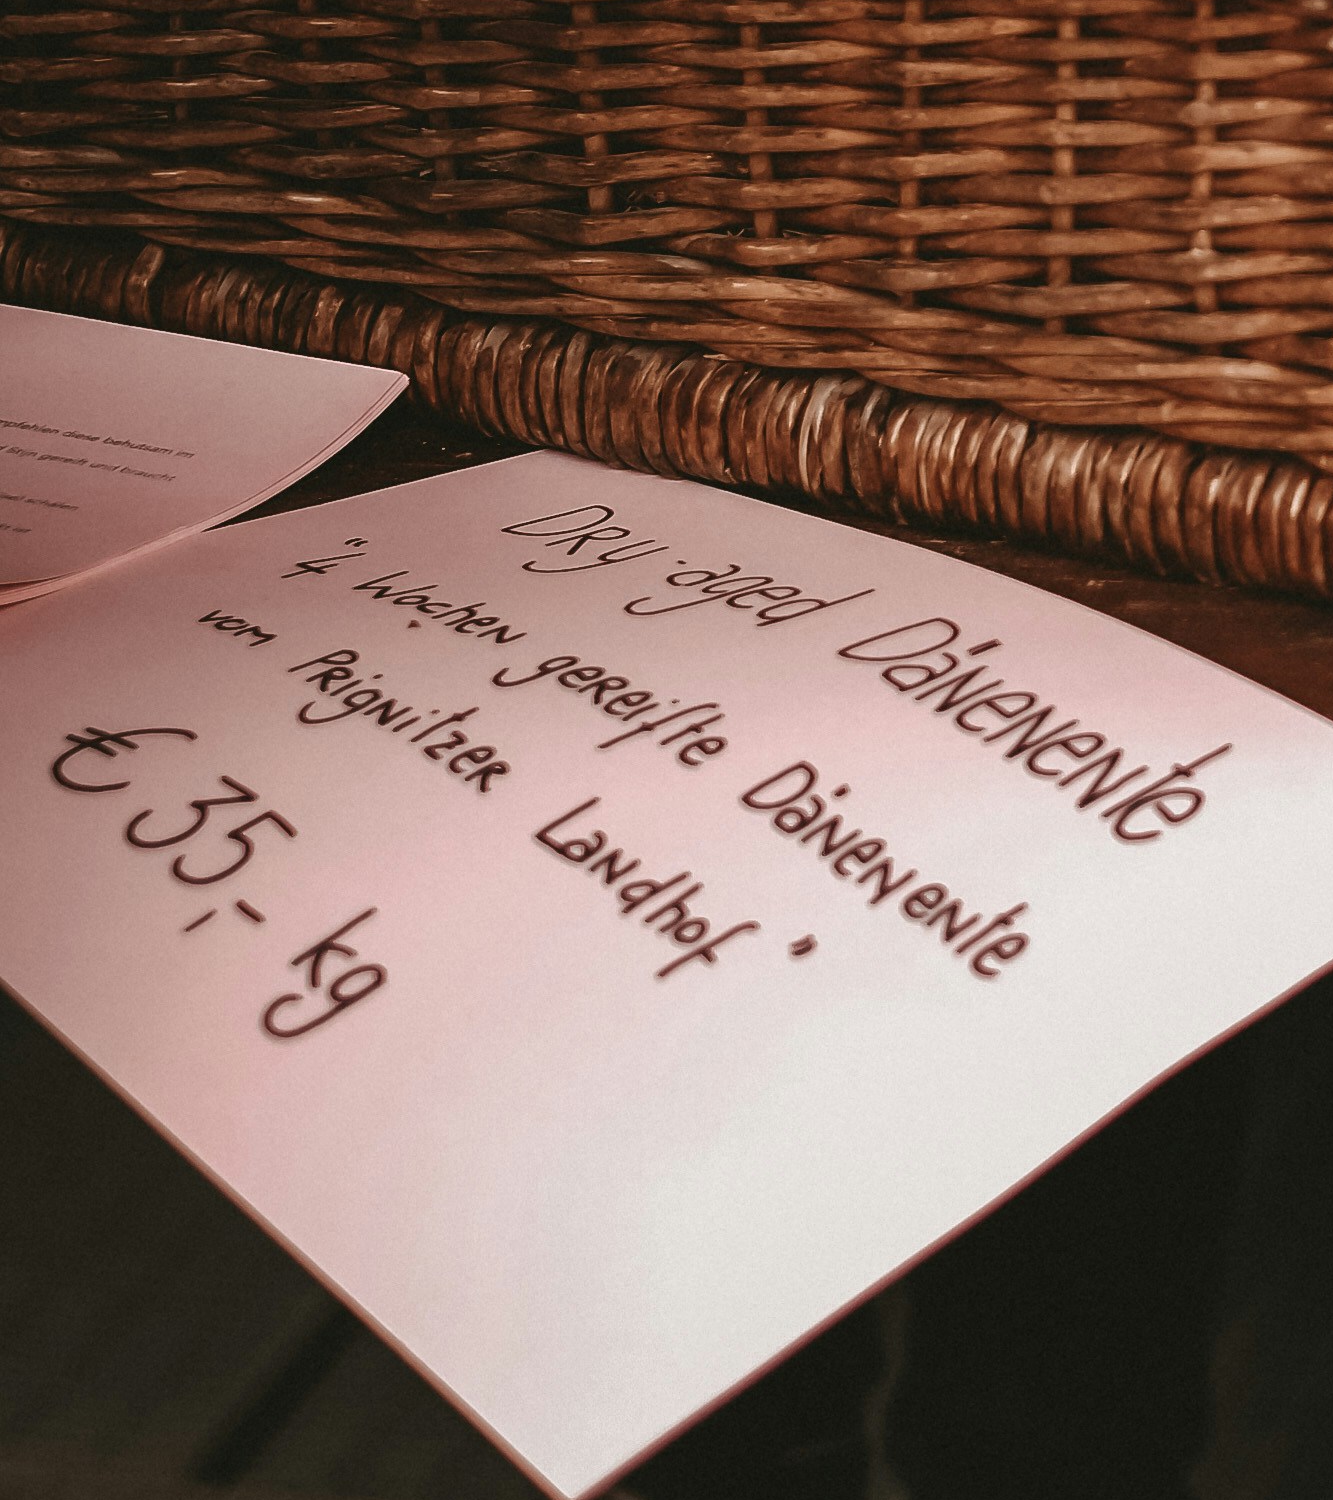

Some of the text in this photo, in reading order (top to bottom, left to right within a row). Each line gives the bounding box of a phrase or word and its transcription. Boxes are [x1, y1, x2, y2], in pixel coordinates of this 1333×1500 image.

[198, 610, 279, 647] vom
[287, 649, 512, 794] Prignitzer
[352, 570, 528, 645] Wochen
[491, 655, 729, 767] gereifte
[52, 726, 198, 793] €
[262, 907, 388, 1038] kg
